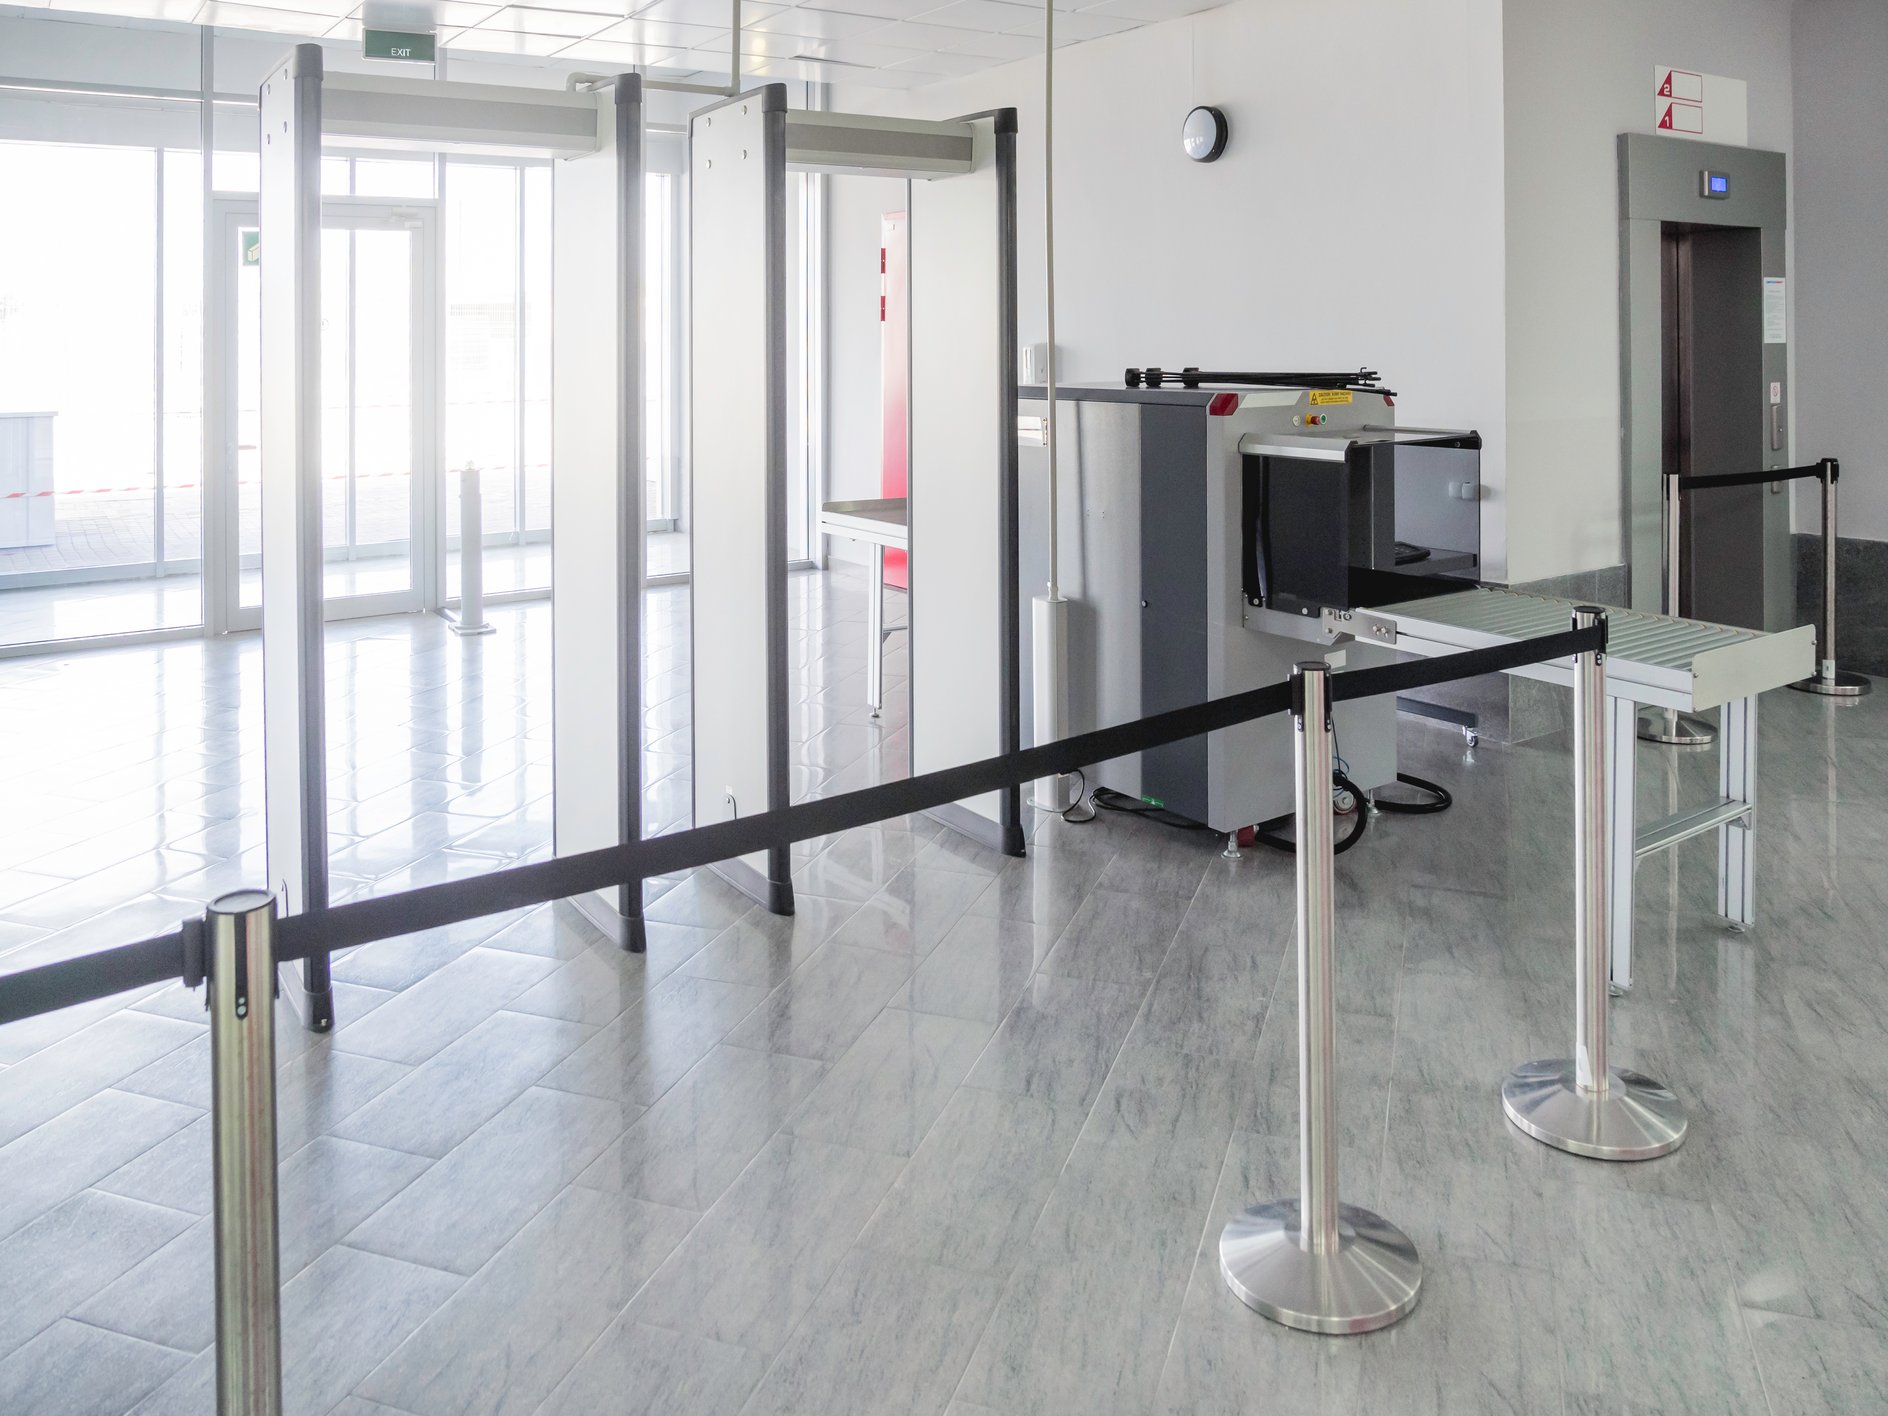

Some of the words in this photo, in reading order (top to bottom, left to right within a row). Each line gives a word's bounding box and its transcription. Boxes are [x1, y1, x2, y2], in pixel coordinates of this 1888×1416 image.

[391, 47, 411, 57] EXIT
[1663, 84, 1671, 95] 2
[1664, 116, 1670, 127] 1
